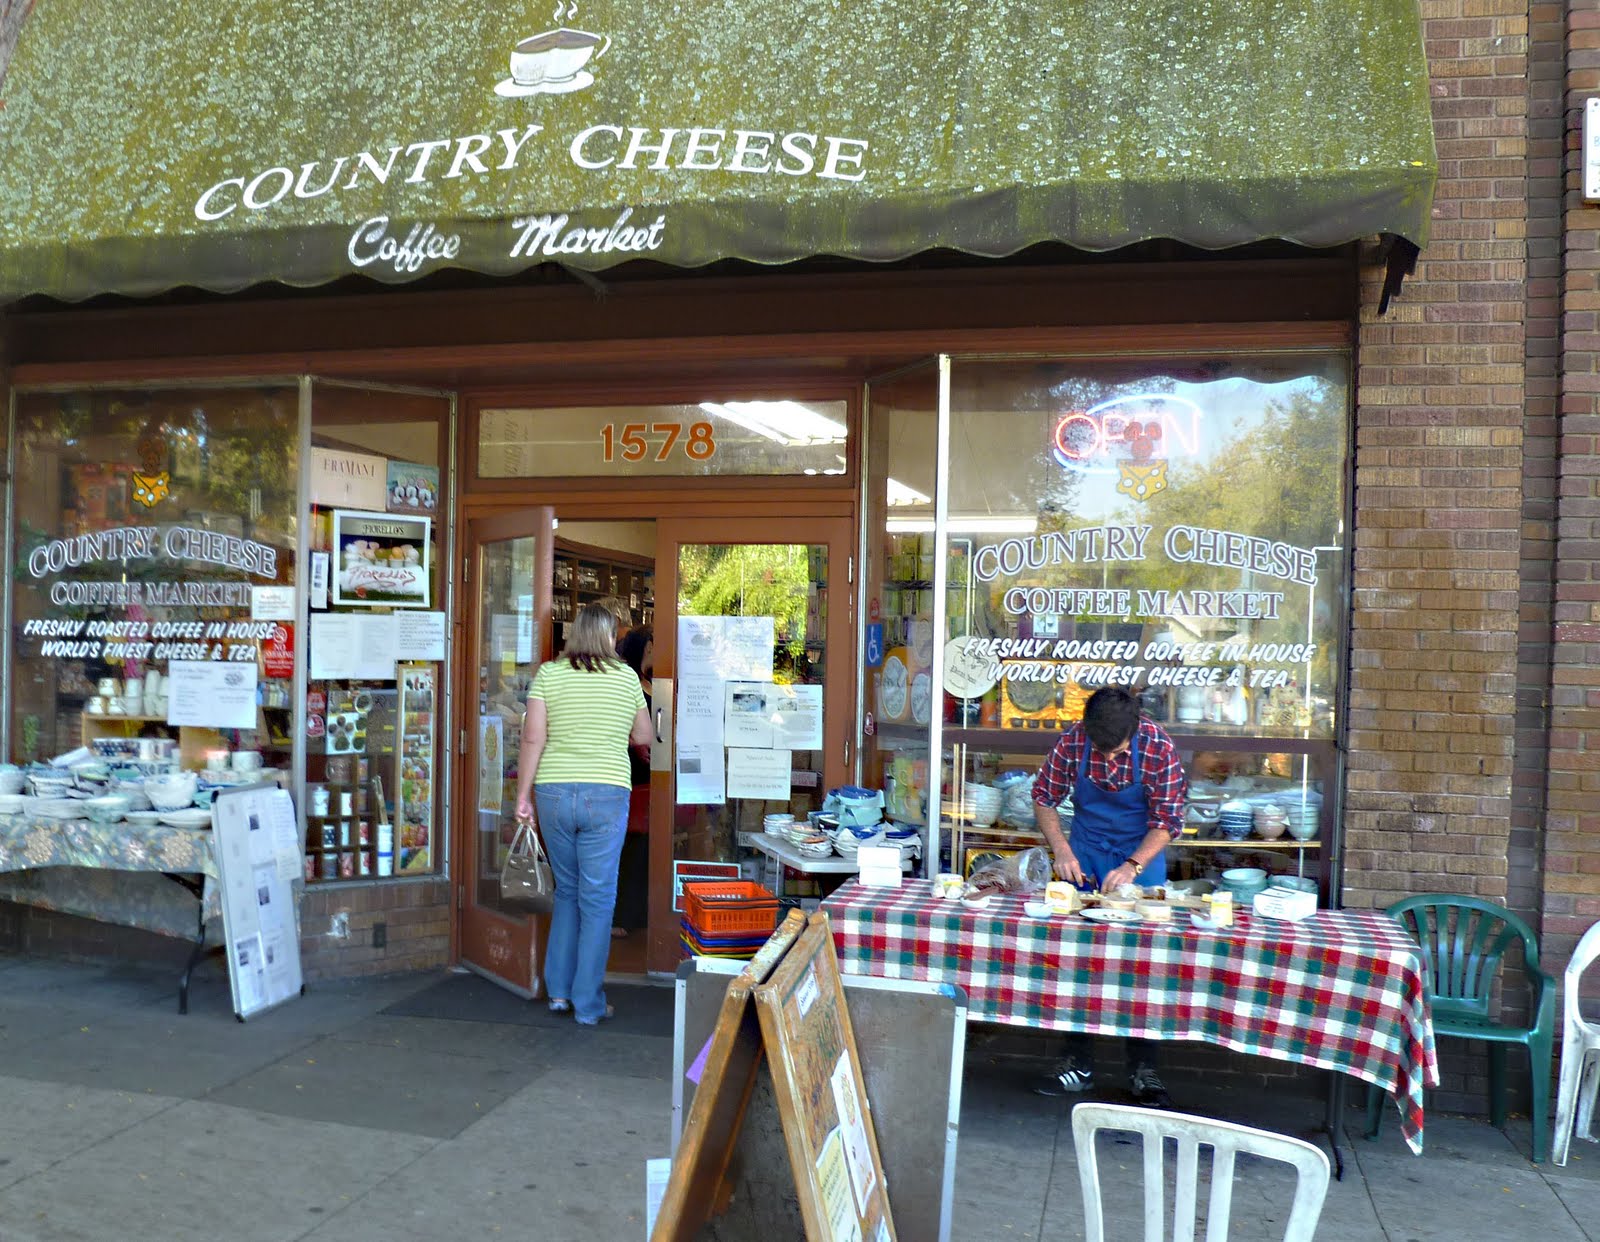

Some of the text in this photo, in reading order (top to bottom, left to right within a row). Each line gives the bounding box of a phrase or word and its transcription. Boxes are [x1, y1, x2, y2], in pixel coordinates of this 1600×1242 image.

[194, 124, 869, 221] COUNTRY CHEESE
[348, 207, 666, 272] Coffee Market
[600, 422, 717, 463] 1578
[28, 526, 157, 578] COUNTRY
[165, 526, 277, 579] CHEESE
[973, 524, 1319, 586] COUNTRY CHEESE
[51, 581, 142, 606] COFFEE
[147, 582, 252, 607] MARKET
[1004, 587, 1284, 620] COFFEE MARKET
[24, 620, 278, 639] FRESHLY ROASTED COFFEE IN HOUSE
[41, 641, 256, 661] WORLD'S FINEST CHEESE & TEA
[963, 638, 1317, 663] FRESHLY ROASTED COFFEE IN HOUSE
[987, 663, 1072, 683] WORLD'S
[1074, 664, 1145, 685] FINEST
[1148, 666, 1222, 687] CHEESE
[1226, 668, 1242, 687] &
[1249, 669, 1289, 688] TEA
[686, 864, 729, 876] WARNING
